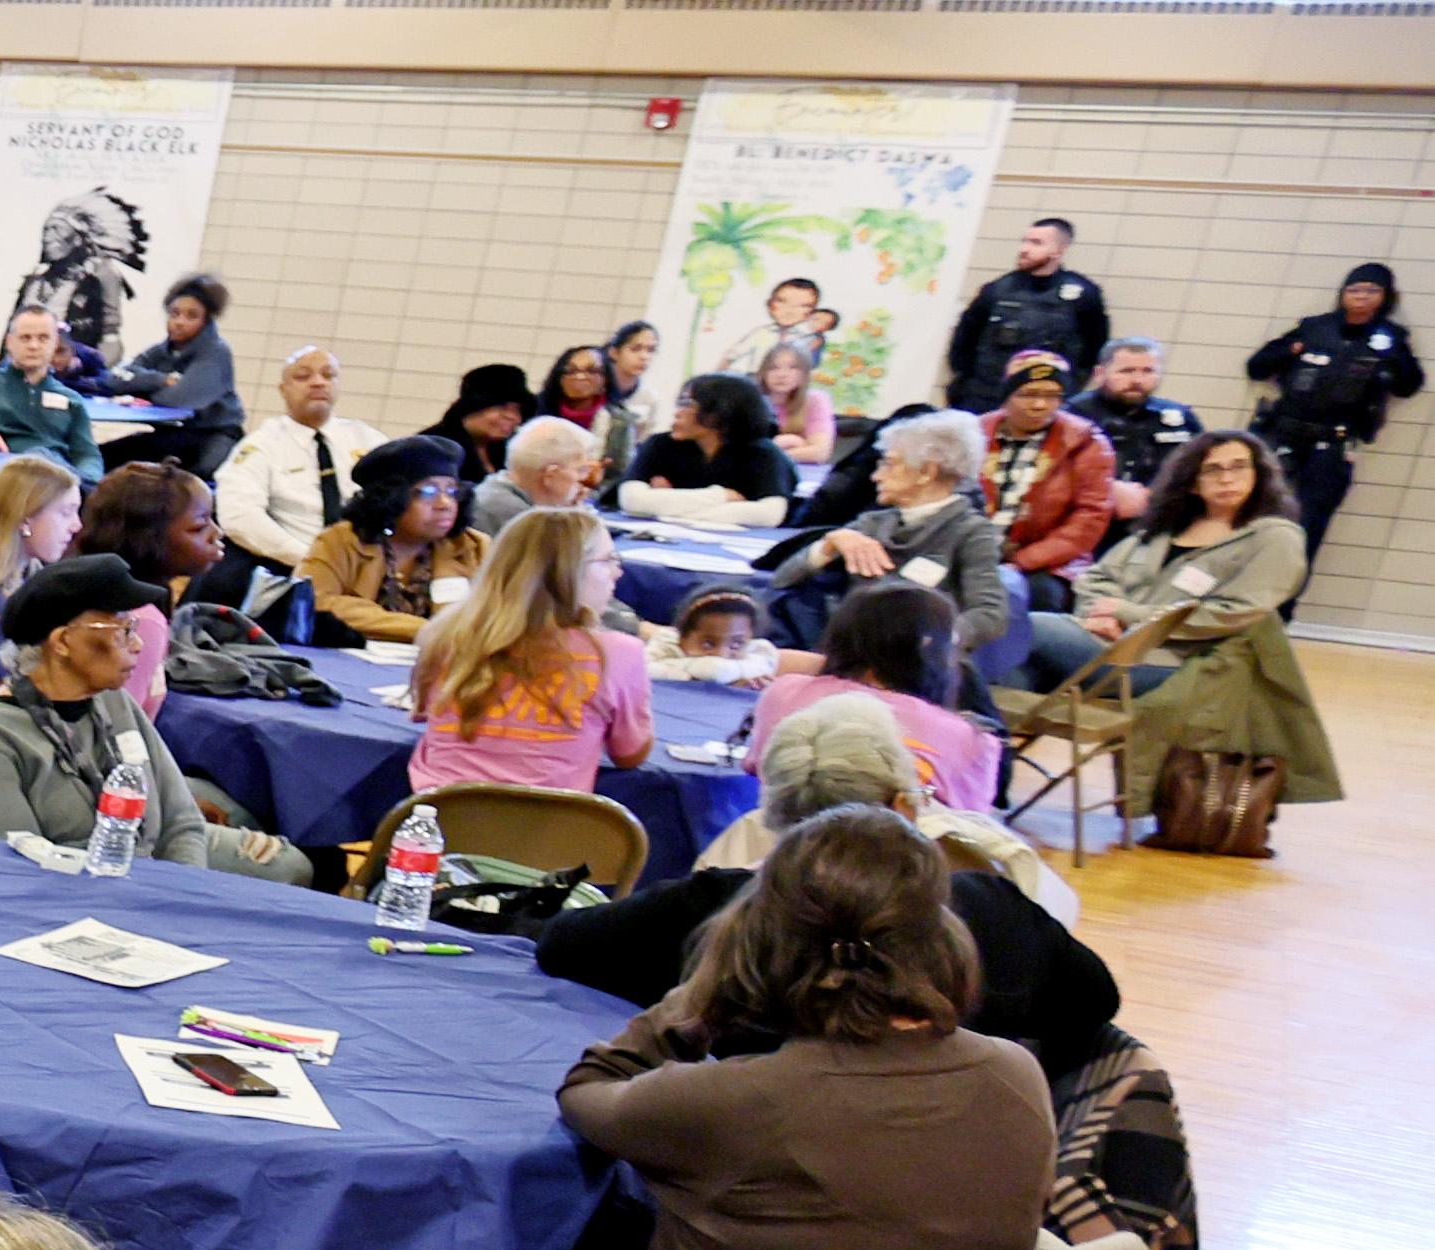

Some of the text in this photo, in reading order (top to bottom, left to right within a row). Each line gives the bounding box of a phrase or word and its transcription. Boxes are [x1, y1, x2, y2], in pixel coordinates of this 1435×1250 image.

[26, 121, 104, 137] SERVANT
[111, 124, 136, 138] OF
[9, 136, 200, 155] NICHOLAS BLACK ELK
[771, 145, 870, 162] BENEDICT
